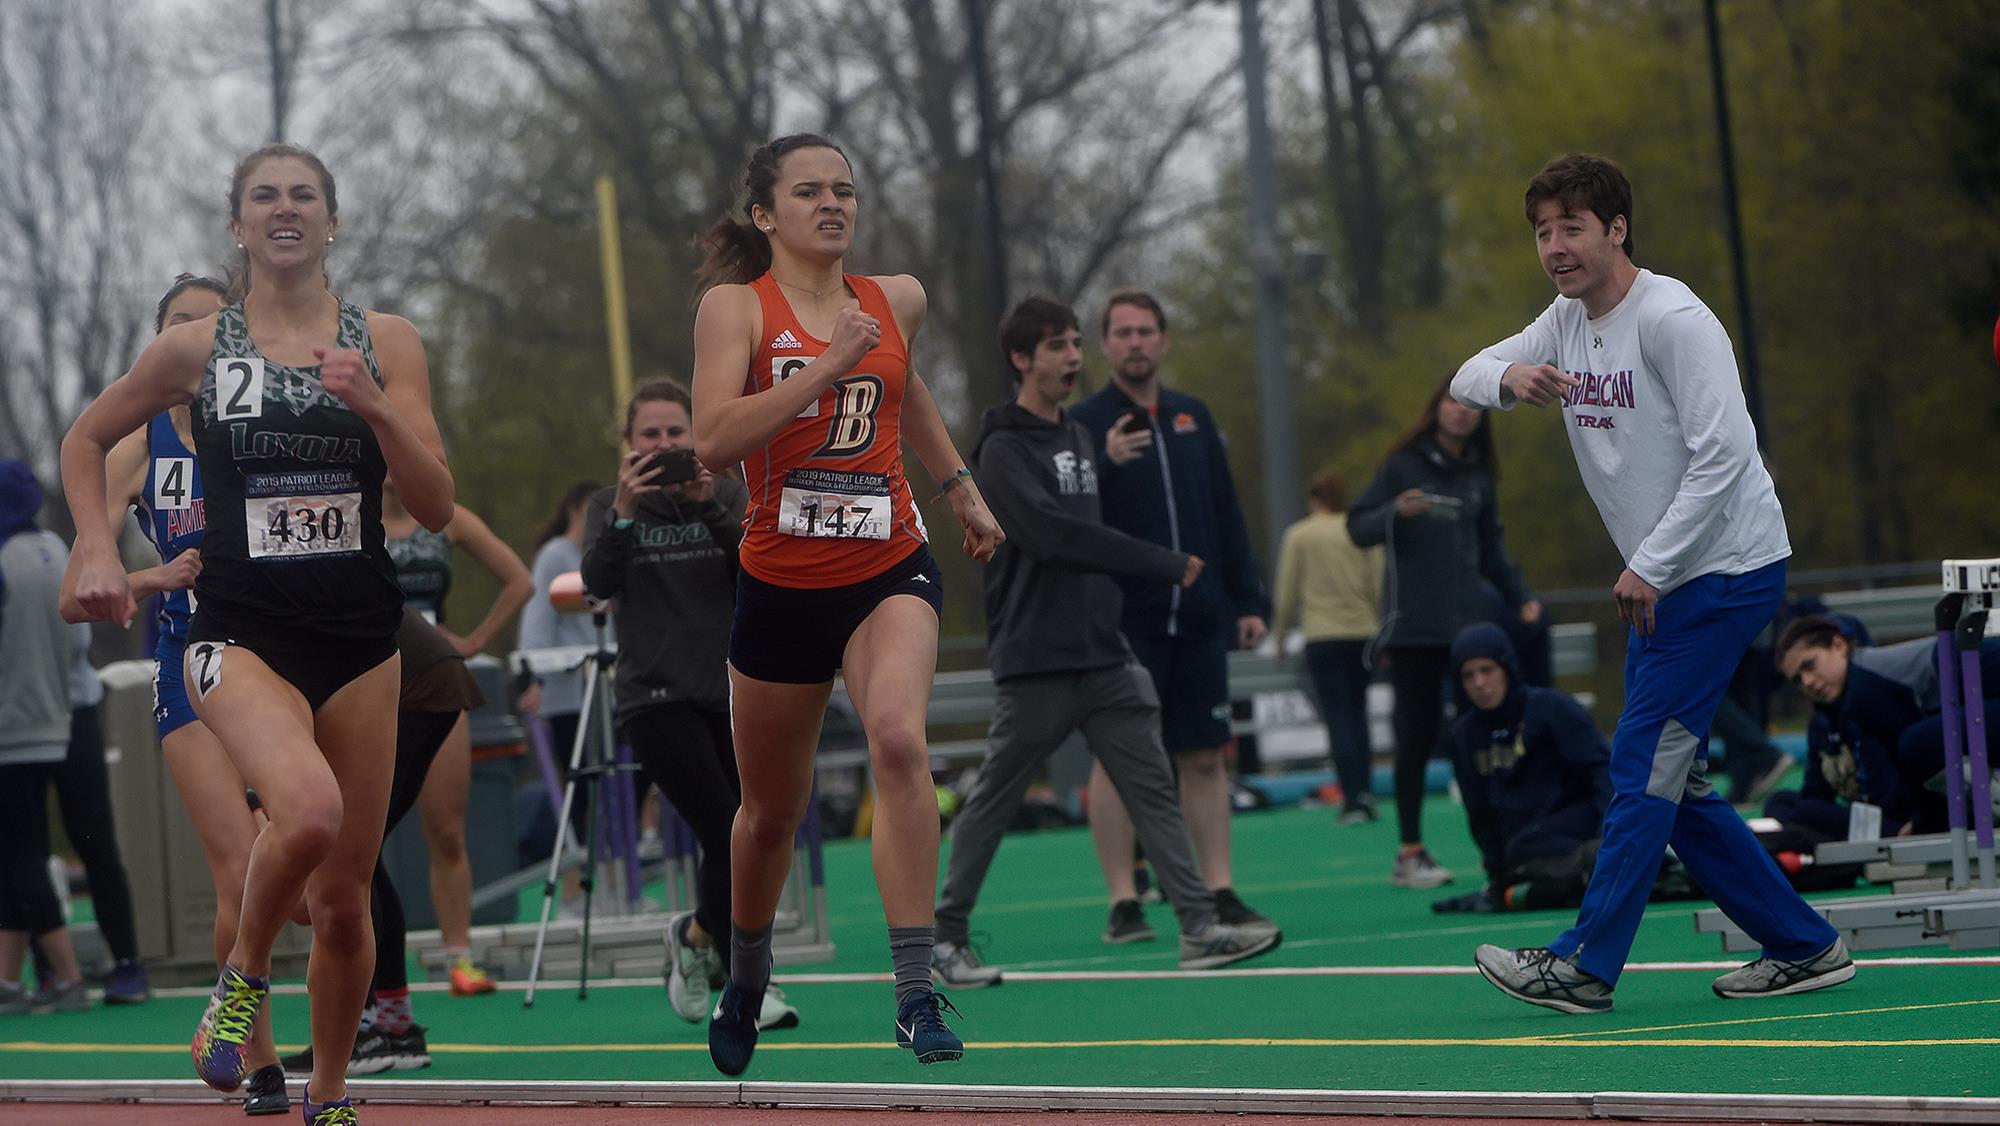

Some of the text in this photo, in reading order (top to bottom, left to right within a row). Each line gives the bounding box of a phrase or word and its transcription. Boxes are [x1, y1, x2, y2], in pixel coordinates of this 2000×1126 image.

[771, 341, 802, 349] adidas
[226, 361, 253, 416] 2
[809, 374, 884, 459] B
[230, 423, 361, 463] LOYOLA
[161, 461, 186, 505] 4
[256, 471, 352, 487] 2019 PATRIOT LEAGUE
[796, 470, 883, 487] 2019 PATRIOT LEAGUE
[269, 507, 344, 543] 430
[802, 503, 873, 535] 147
[195, 643, 216, 696] 2
